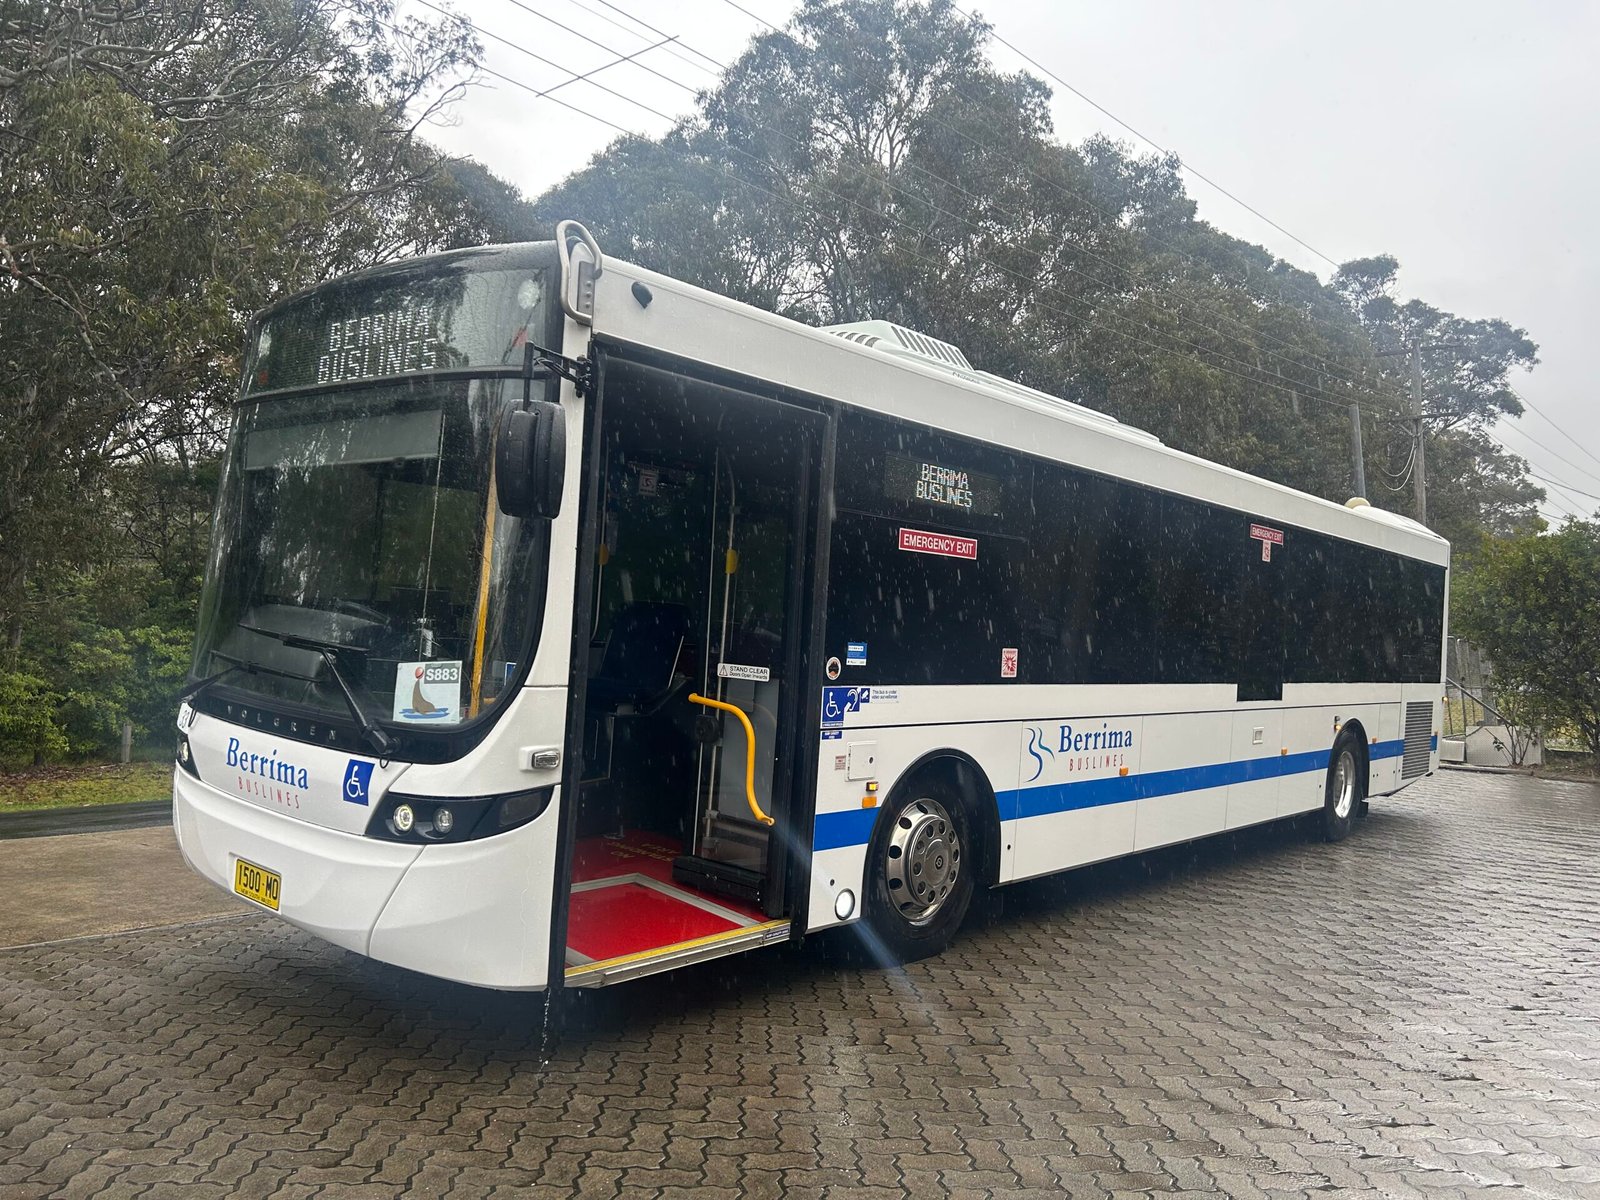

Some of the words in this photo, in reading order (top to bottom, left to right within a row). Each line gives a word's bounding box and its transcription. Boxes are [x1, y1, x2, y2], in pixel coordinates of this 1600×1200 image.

[330, 305, 429, 351] BERRIMA
[318, 338, 437, 384] BUSLINES
[921, 463, 969, 490] BERRIMA
[916, 480, 973, 508] BUSLINES
[903, 533, 955, 552] EMERGENCY
[956, 541, 974, 555] EXIT
[425, 668, 459, 681] S883
[730, 665, 748, 673] STAND
[227, 705, 337, 741] VOLGREN
[1058, 723, 1132, 752] Berrima
[226, 737, 309, 790] Berrima
[1069, 754, 1123, 772] BUSLINES
[238, 776, 300, 809] BUSLINES
